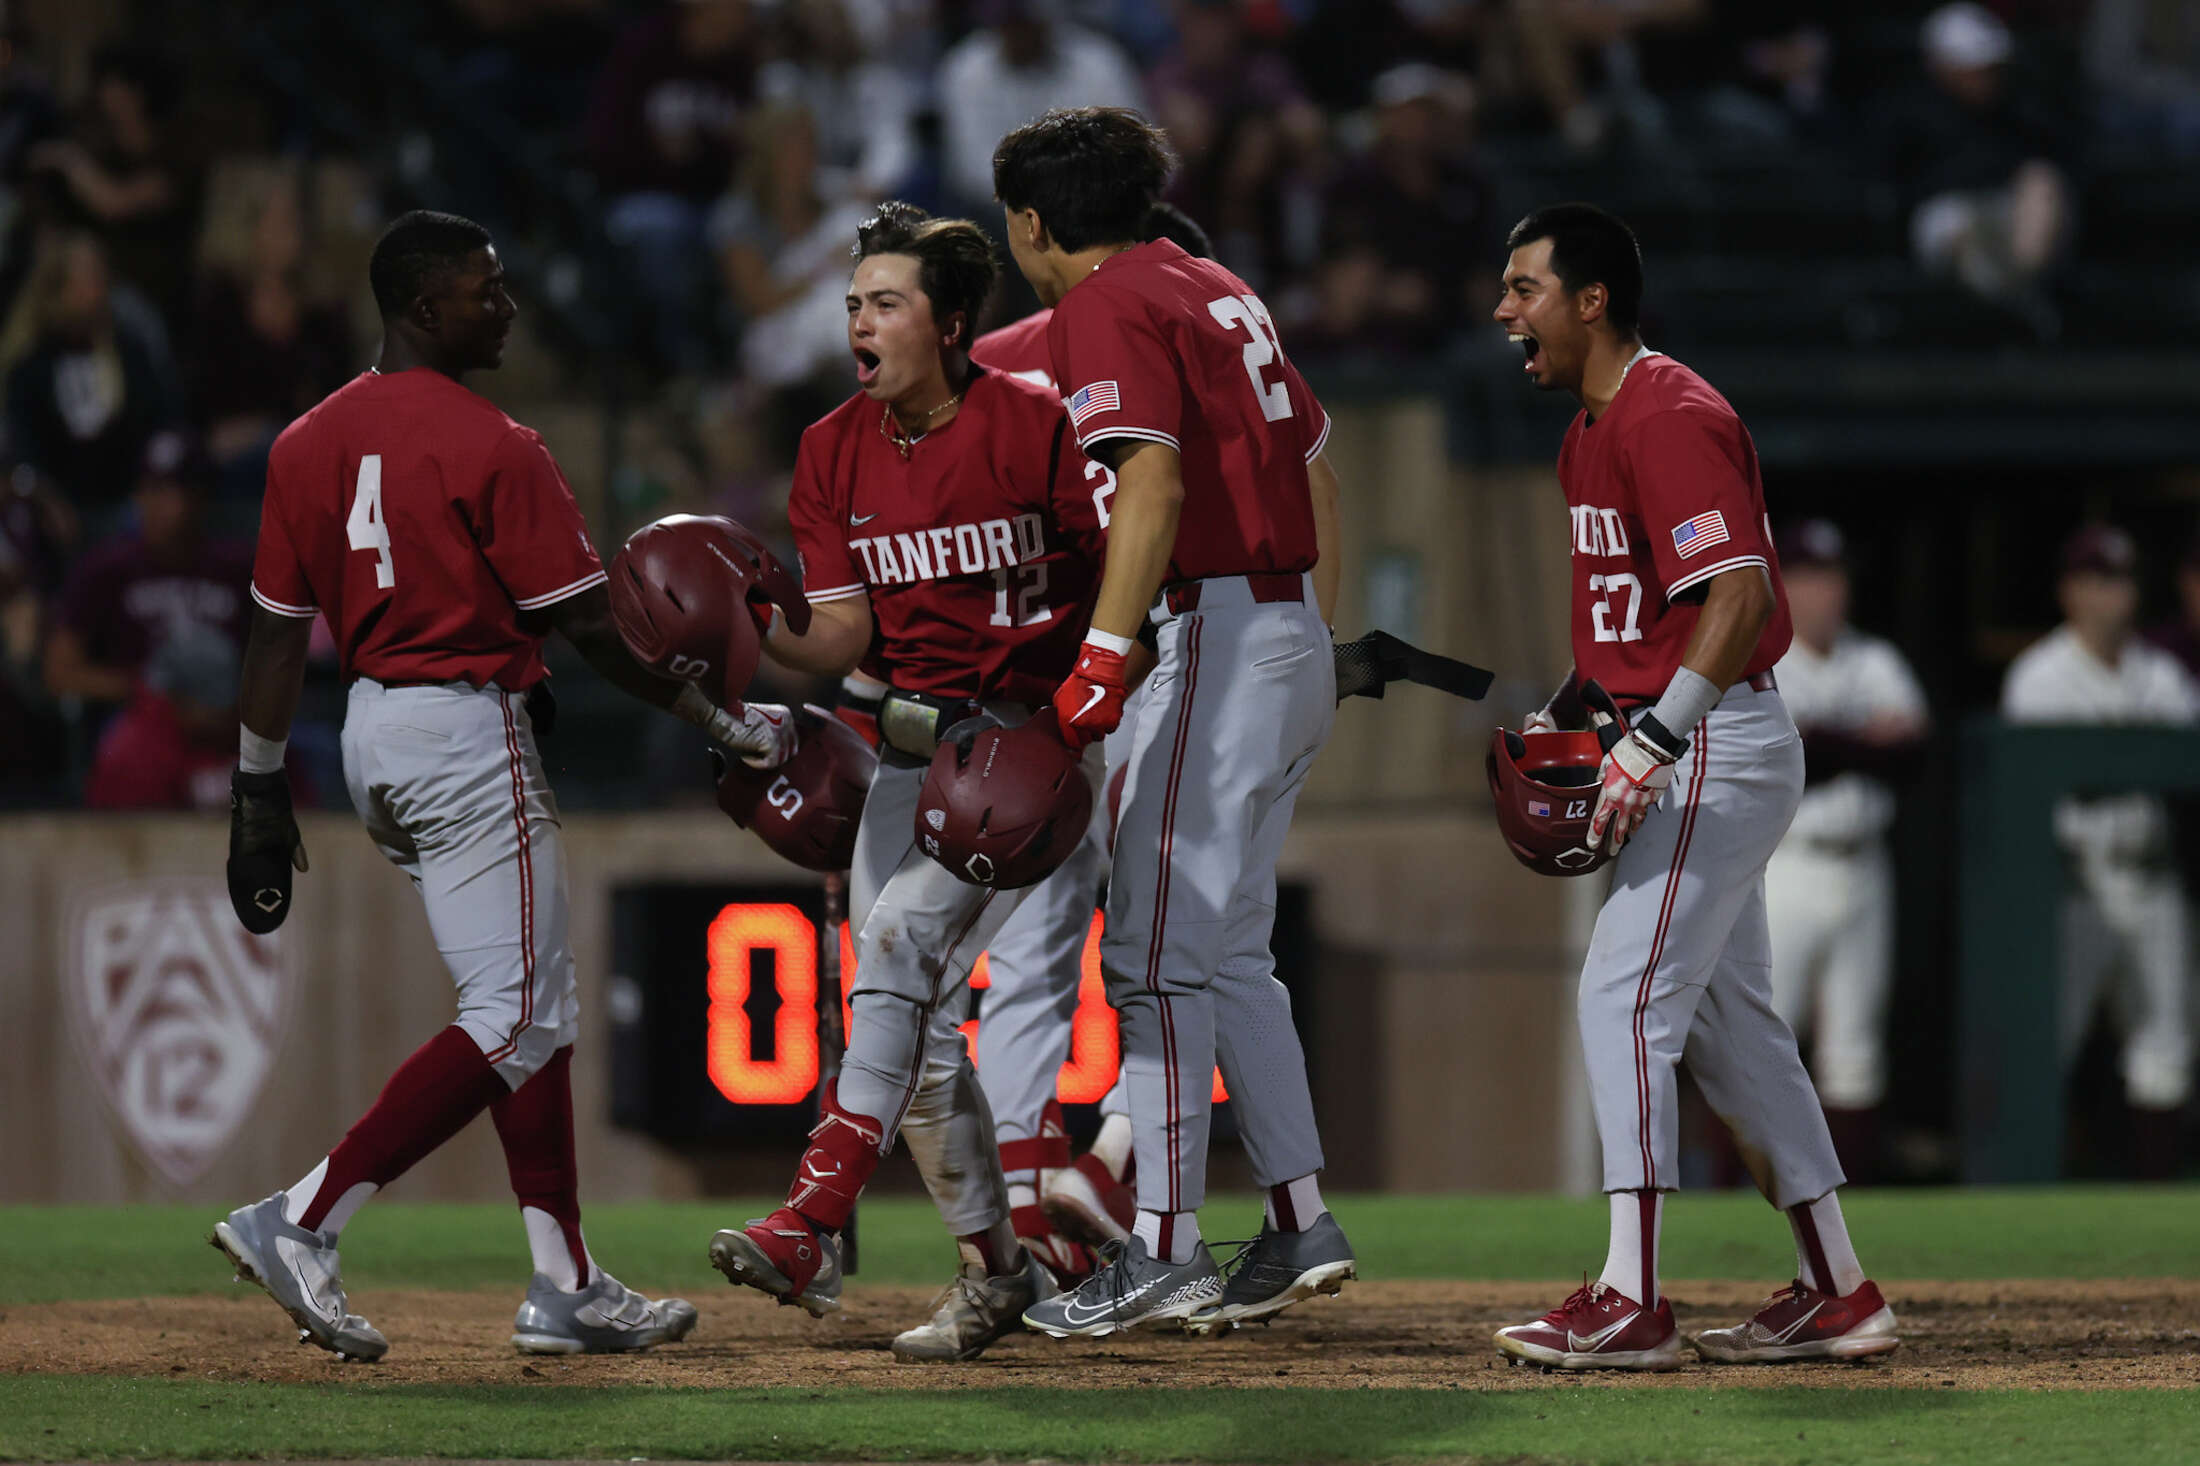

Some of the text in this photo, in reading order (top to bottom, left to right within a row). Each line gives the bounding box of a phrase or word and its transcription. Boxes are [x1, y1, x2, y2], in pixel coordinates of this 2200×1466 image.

[346, 454, 395, 589] 4
[1084, 460, 1117, 529] 2
[849, 513, 1045, 584] TANFORD
[989, 563, 1052, 627] 12
[1590, 573, 1643, 643] 27
[669, 654, 710, 677] S
[767, 774, 803, 821] S
[1565, 800, 1587, 819] 27
